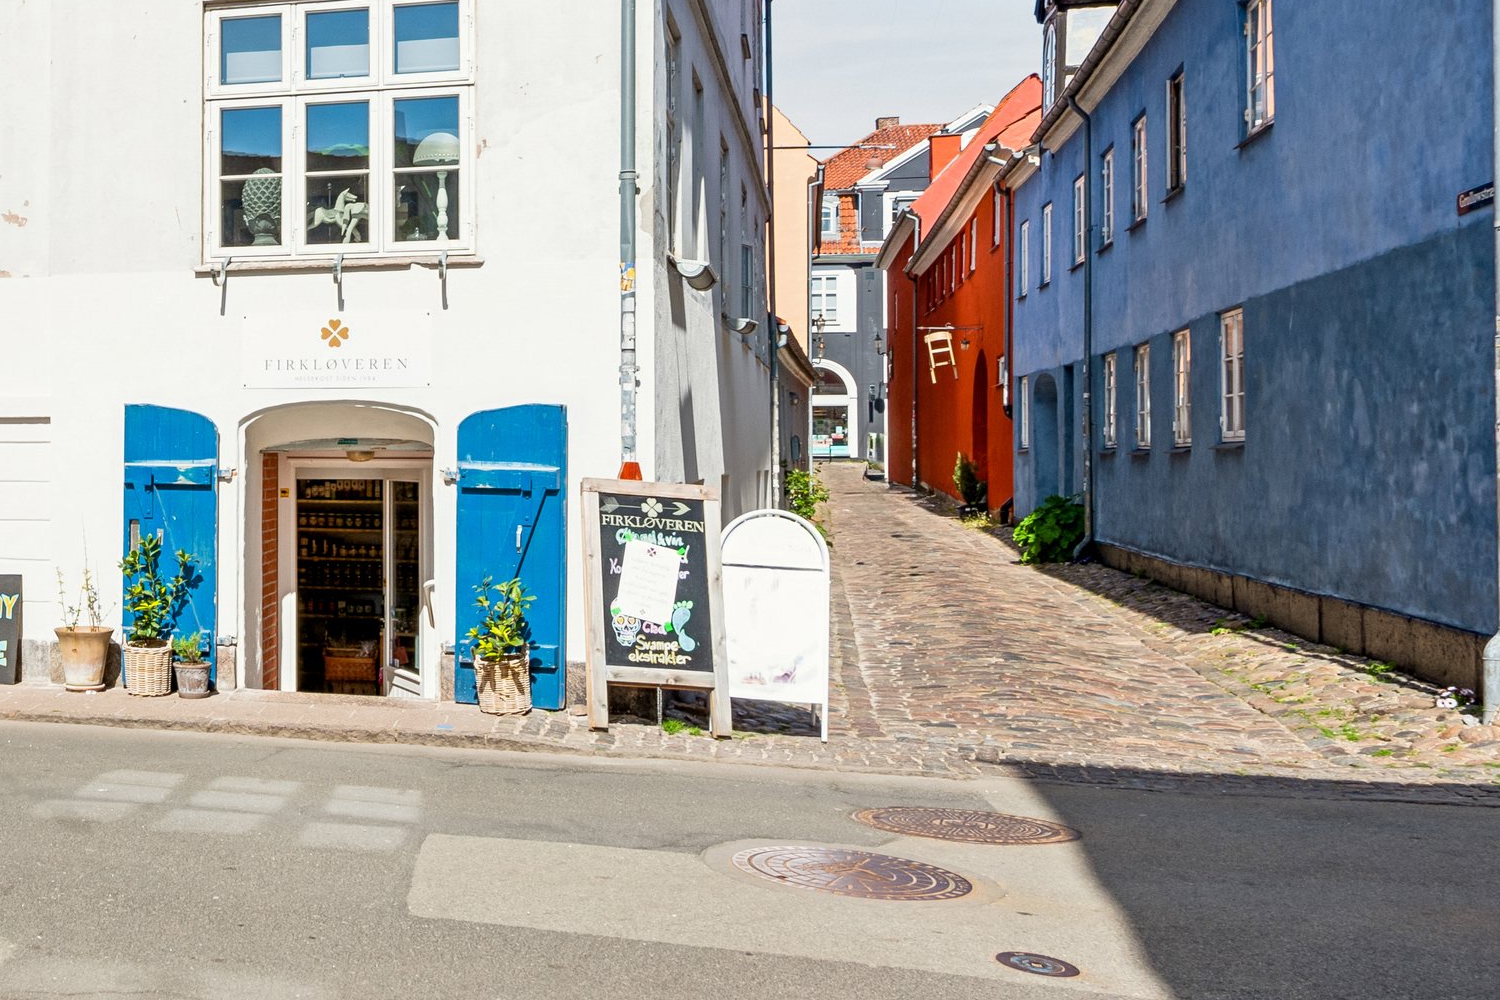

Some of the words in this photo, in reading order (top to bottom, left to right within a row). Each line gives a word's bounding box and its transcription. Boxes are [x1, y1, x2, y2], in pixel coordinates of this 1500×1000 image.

[265, 358, 408, 371] FIRKLØVEREN
[601, 514, 705, 533] FIRKLØVEREN
[628, 649, 692, 665] ekstrakter
